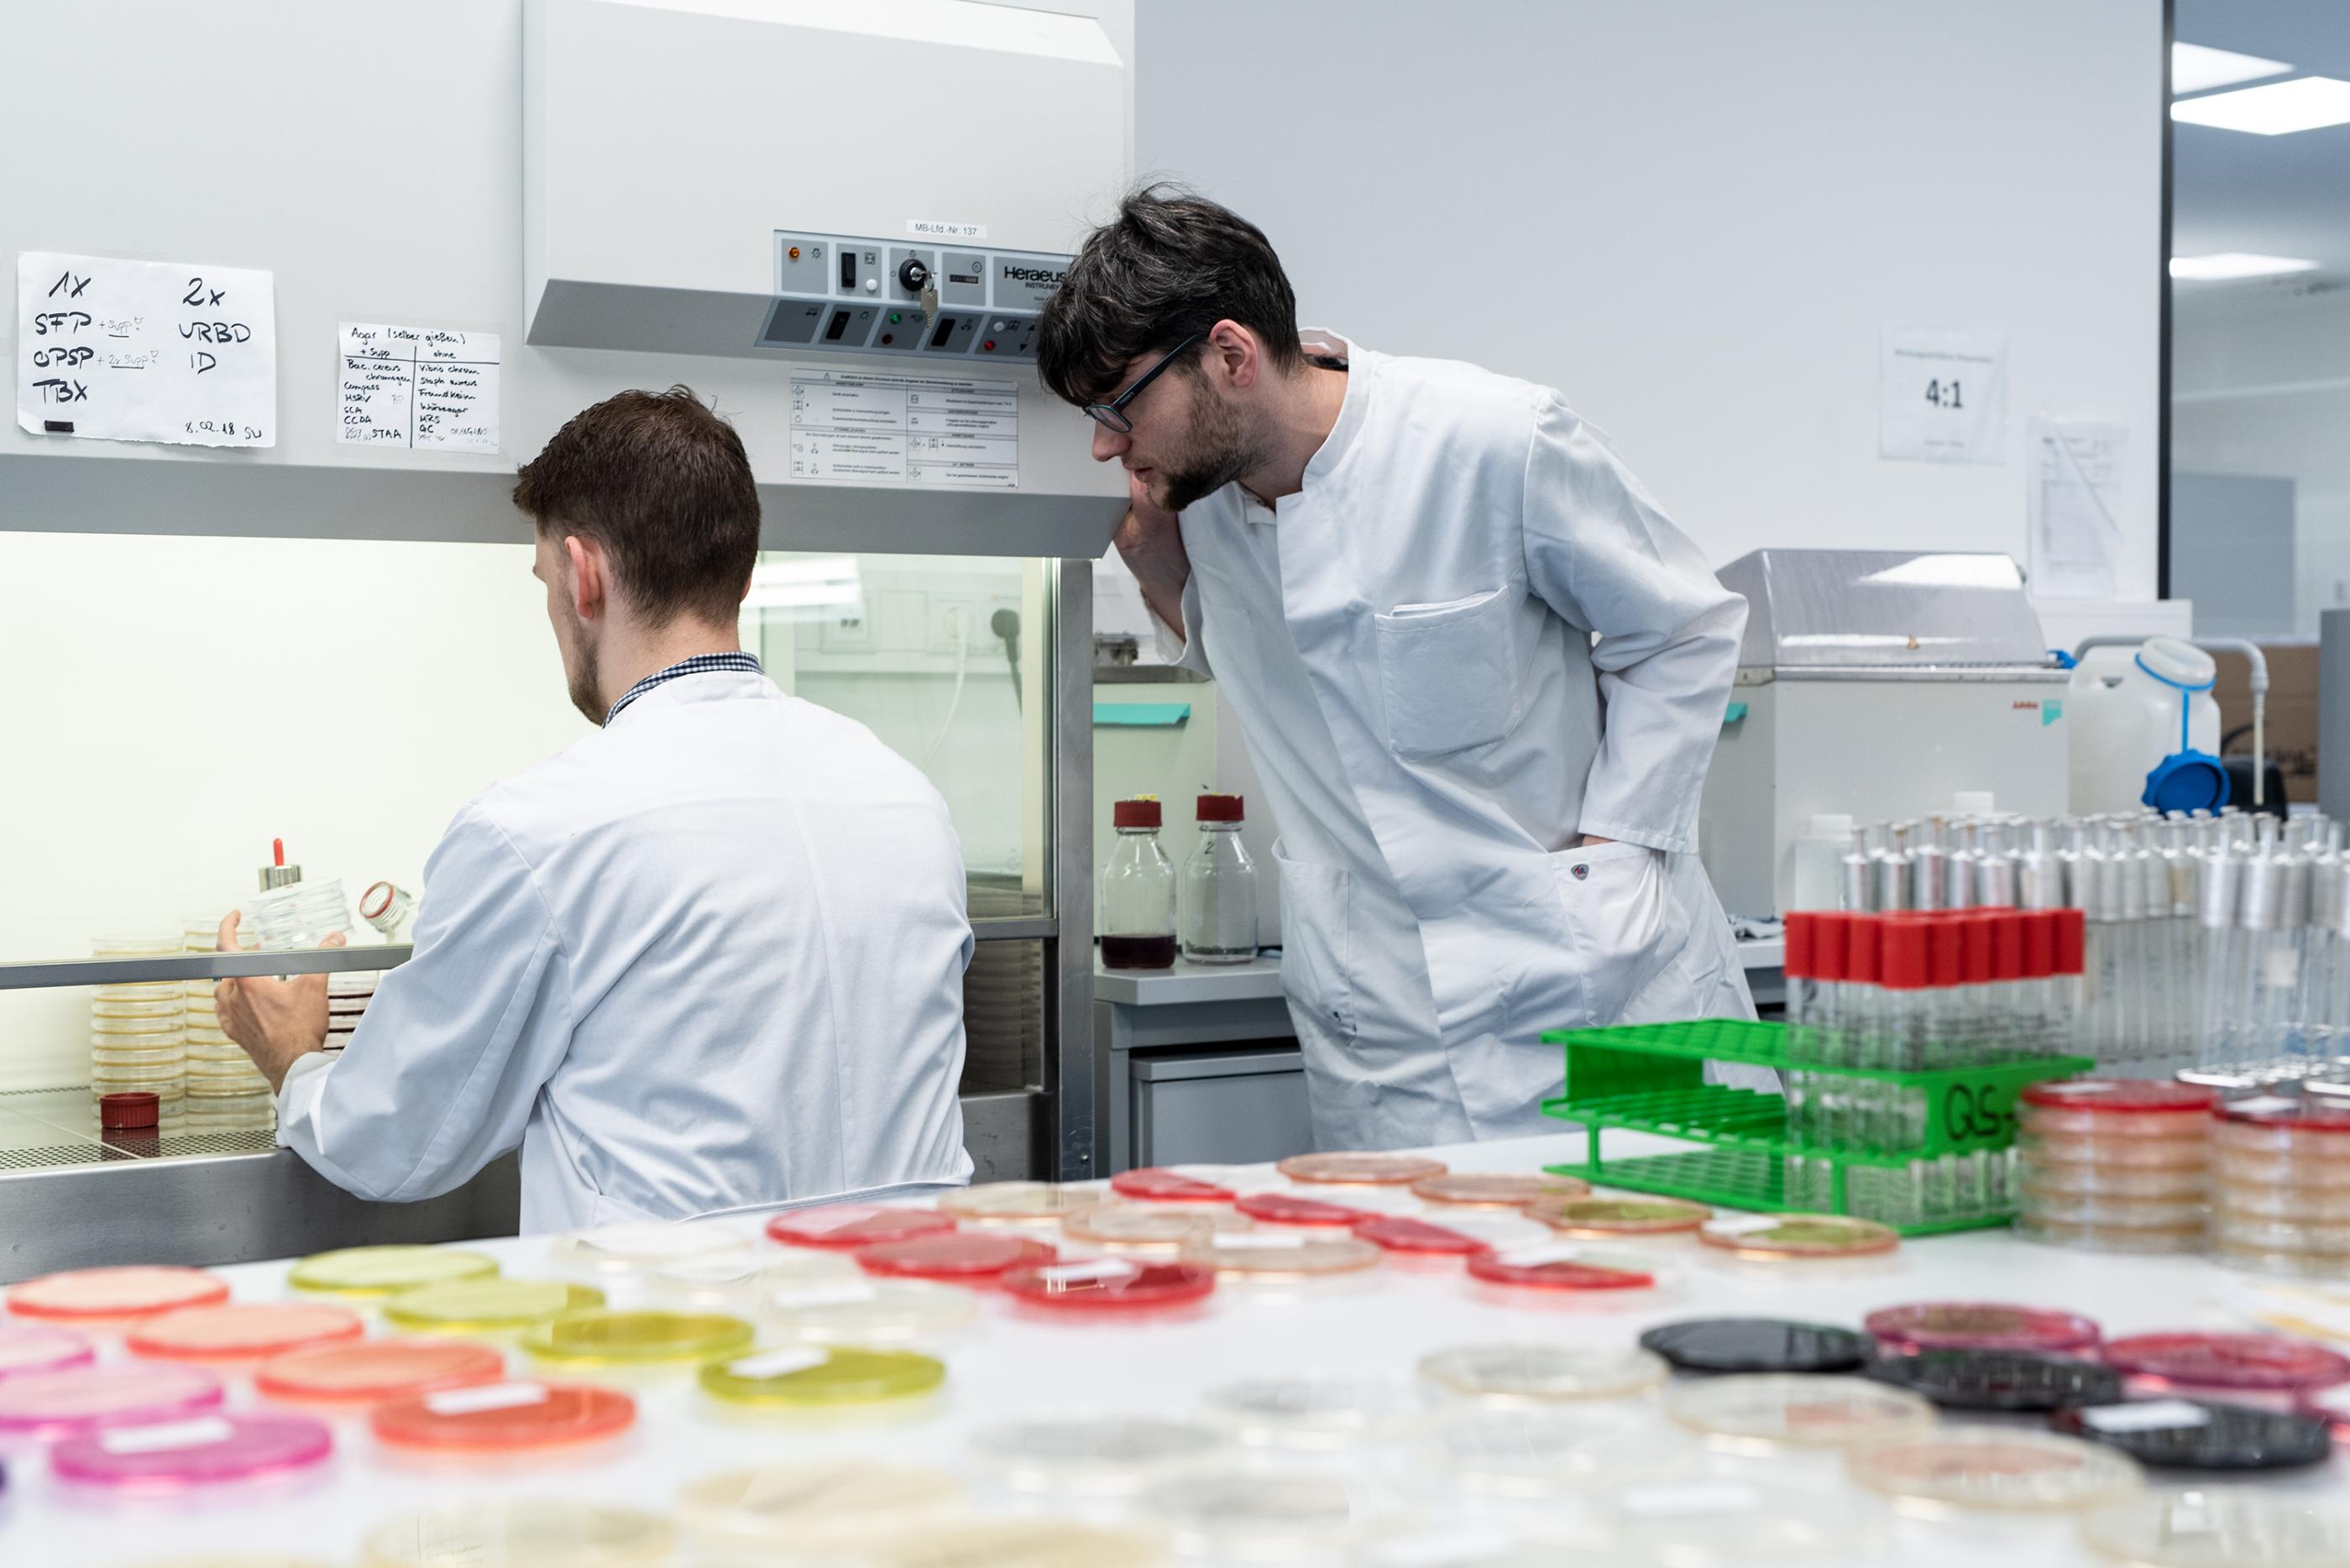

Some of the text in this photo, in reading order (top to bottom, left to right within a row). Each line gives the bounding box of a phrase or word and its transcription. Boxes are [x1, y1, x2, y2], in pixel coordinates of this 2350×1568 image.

[964, 227, 977, 236] 137
[1004, 266, 1068, 283] Heraeus
[35, 311, 92, 335] SFP
[351, 327, 376, 345] Agar
[1925, 379, 1964, 408] 4:1
[1204, 841, 1215, 855] 2
